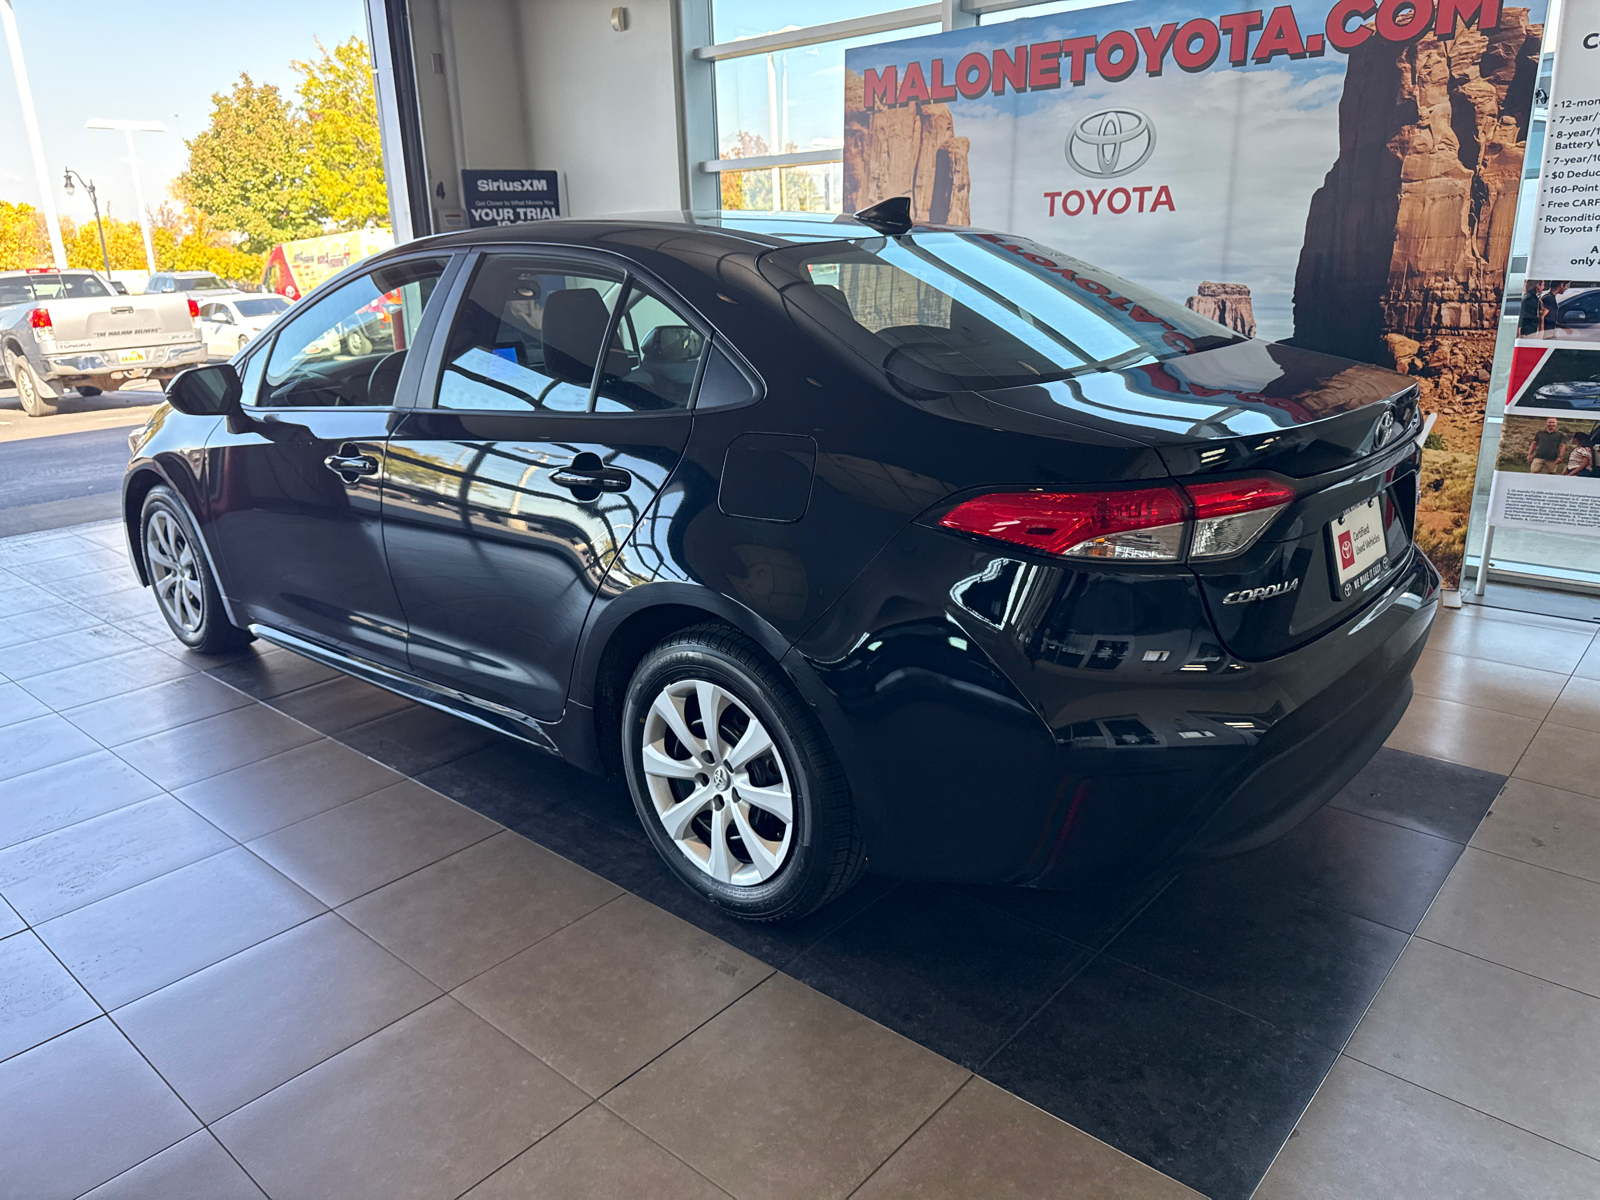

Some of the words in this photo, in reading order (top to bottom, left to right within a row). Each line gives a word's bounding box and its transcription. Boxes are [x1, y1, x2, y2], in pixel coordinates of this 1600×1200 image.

[1582, 33, 1600, 50] C
[864, 0, 1503, 109] MALONETOYOTA.COM
[1561, 99, 1600, 109] 12-mon
[1559, 112, 1600, 124] 7-year/
[1555, 140, 1594, 151] Battery
[1551, 171, 1564, 180] $0
[477, 179, 548, 192] SiriusXM
[1549, 184, 1599, 194] 160-Point
[1044, 185, 1176, 217] TOYOTA
[1547, 200, 1570, 208] Free
[1572, 198, 1600, 207] CARF
[471, 208, 515, 221] YOUR
[516, 207, 560, 220] TRIAL
[1543, 226, 1556, 235] by
[1559, 225, 1593, 235] Toyota
[1570, 257, 1595, 267] only
[1352, 523, 1370, 542] Certified
[1355, 543, 1366, 556] Used
[1365, 534, 1381, 549] Vehicles
[1353, 579, 1361, 590] WE
[1360, 571, 1370, 586] MAKE
[1222, 577, 1299, 605] COROLLA
